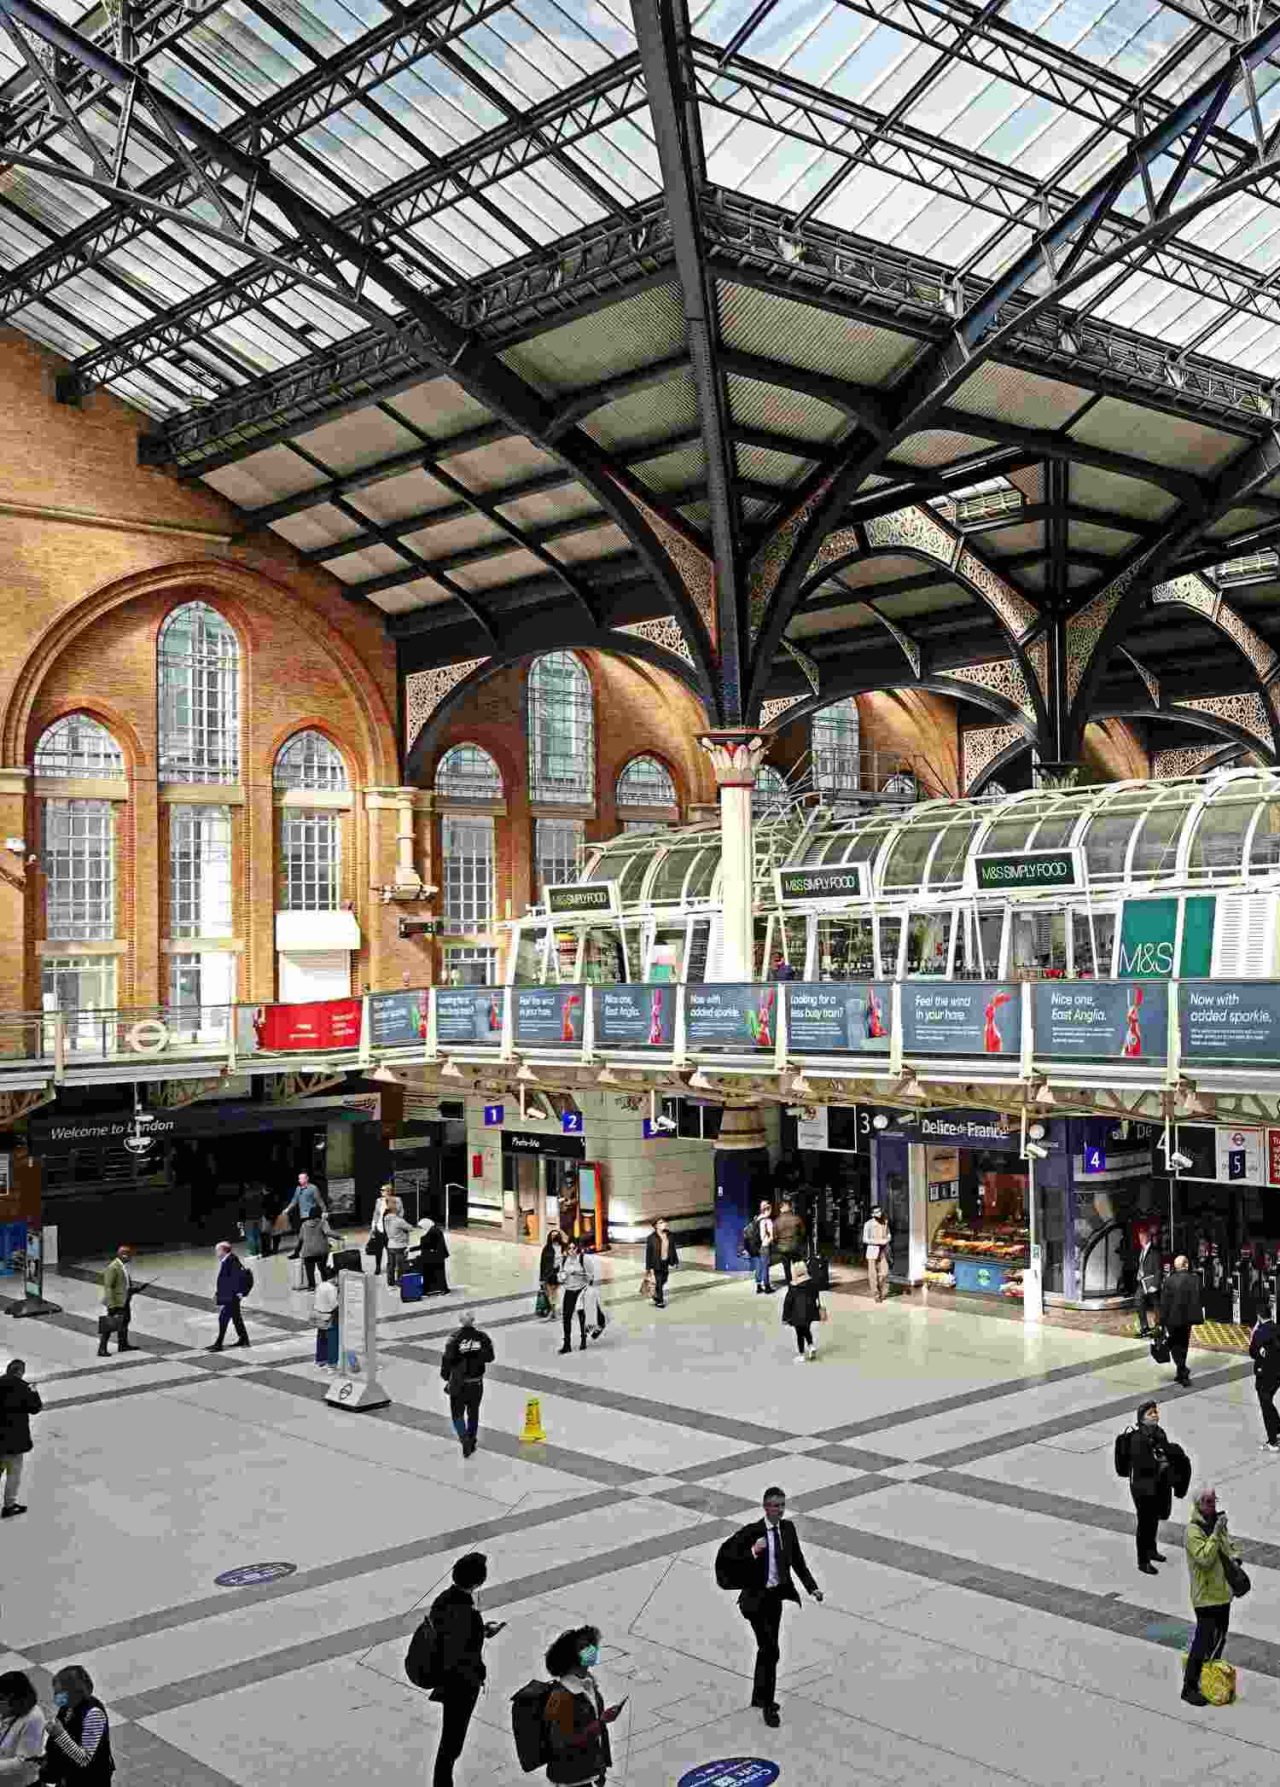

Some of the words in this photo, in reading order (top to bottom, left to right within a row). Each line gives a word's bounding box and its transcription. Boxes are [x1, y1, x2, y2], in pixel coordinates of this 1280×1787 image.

[1037, 862, 1067, 877] FOOD
[831, 875, 856, 889] FOOD
[1119, 941, 1174, 973] M&S
[1051, 993, 1072, 1006] Nice
[1190, 993, 1214, 1005] Now
[1216, 992, 1240, 1005] with
[925, 1011, 944, 1022] your
[1051, 1008, 1073, 1021] East
[1074, 1008, 1107, 1023] Anglia.
[1190, 1009, 1226, 1022] added
[1229, 1010, 1273, 1025] sparkle.
[491, 1109, 497, 1121] 1
[568, 1115, 577, 1128] 2
[51, 1125, 108, 1140] Welcome
[111, 1124, 124, 1135] to
[127, 1120, 175, 1133] Lndon
[860, 1113, 871, 1134] 3
[921, 1119, 957, 1136] Delice
[1090, 1151, 1100, 1169] 4
[1233, 1155, 1241, 1174] 5
